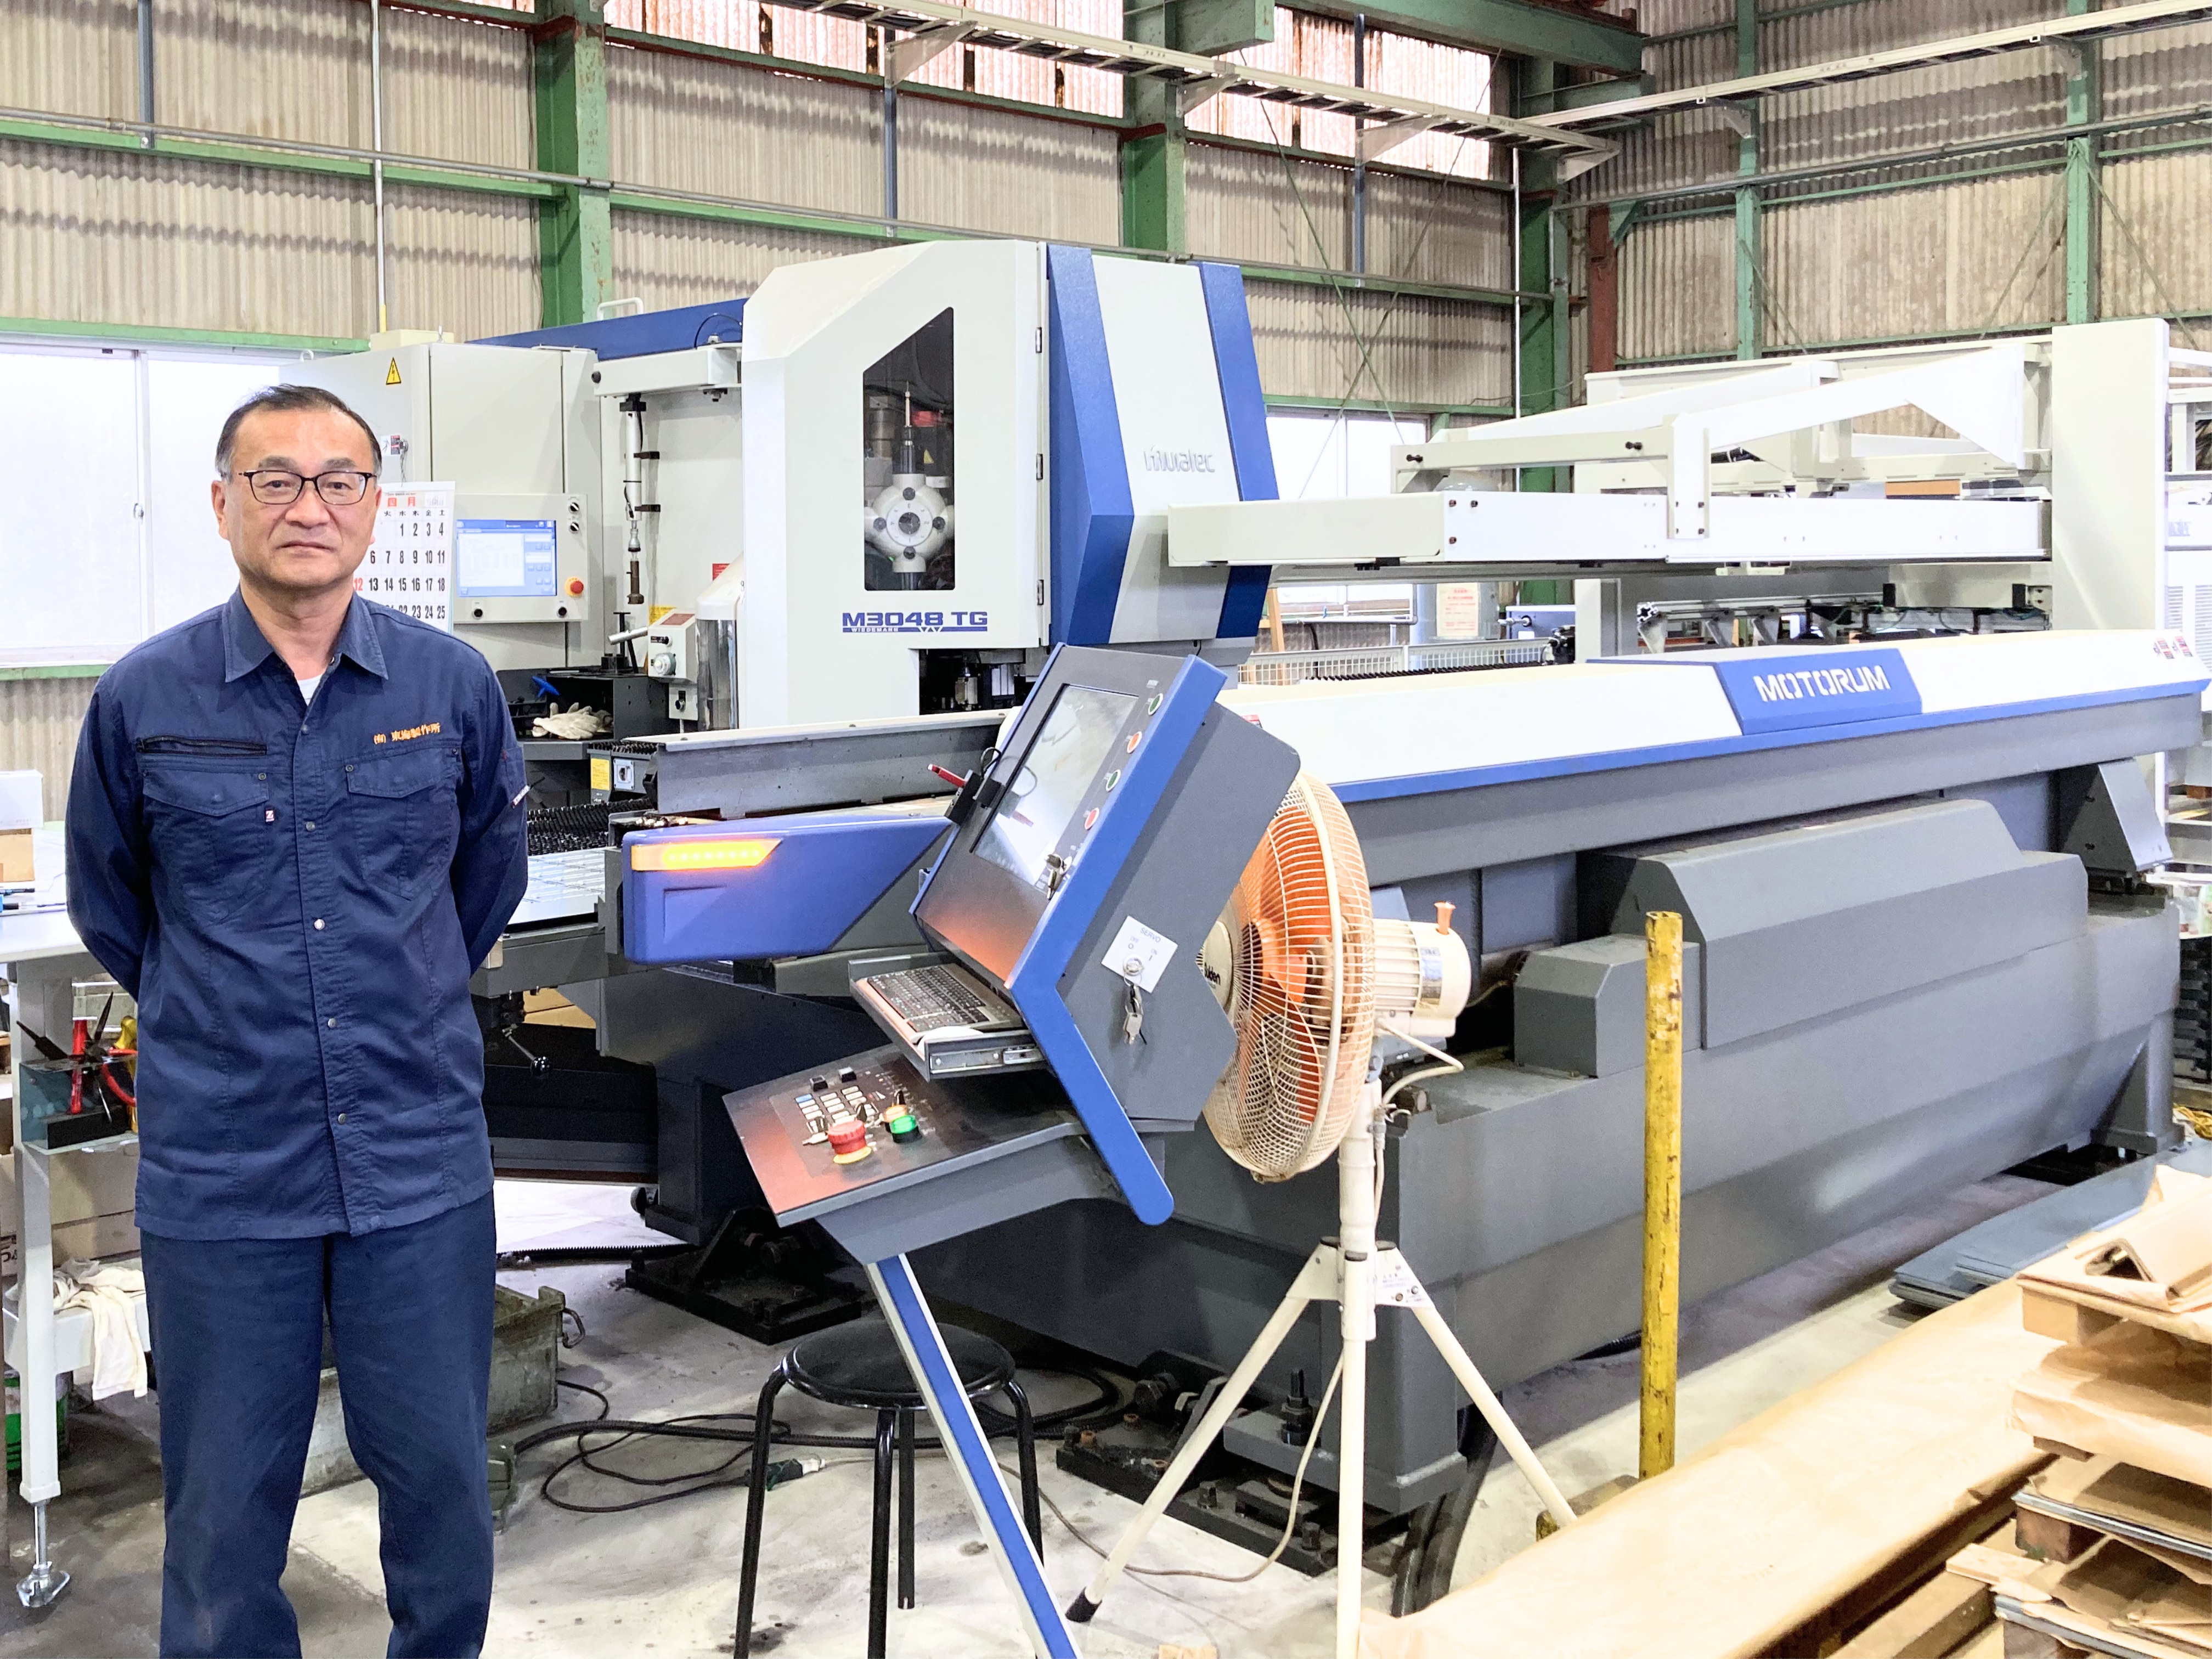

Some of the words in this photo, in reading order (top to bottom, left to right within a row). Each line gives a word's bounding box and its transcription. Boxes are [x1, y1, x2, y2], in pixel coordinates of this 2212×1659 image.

[400, 523, 404, 537] 1
[413, 523, 418, 537] 2
[426, 522, 431, 537] 3
[439, 522, 444, 536] 4
[370, 550, 375, 564] 6
[386, 551, 391, 564] 7
[399, 550, 404, 564] 8
[413, 550, 417, 564] 9
[425, 550, 432, 564] 10
[437, 550, 445, 564] 11
[354, 578, 363, 591] 12
[369, 578, 379, 591] 13
[385, 578, 393, 591] 14
[398, 578, 407, 591] 15
[411, 578, 420, 591] 16
[425, 578, 433, 591] 17
[438, 578, 445, 591] 18
[412, 605, 421, 618] 23
[425, 605, 433, 619] 24
[437, 605, 445, 619] 25
[842, 612, 943, 627] M3048
[951, 611, 988, 625] TG
[1753, 664, 1892, 702] MOTORUM
[1140, 927, 1161, 943] SERVO
